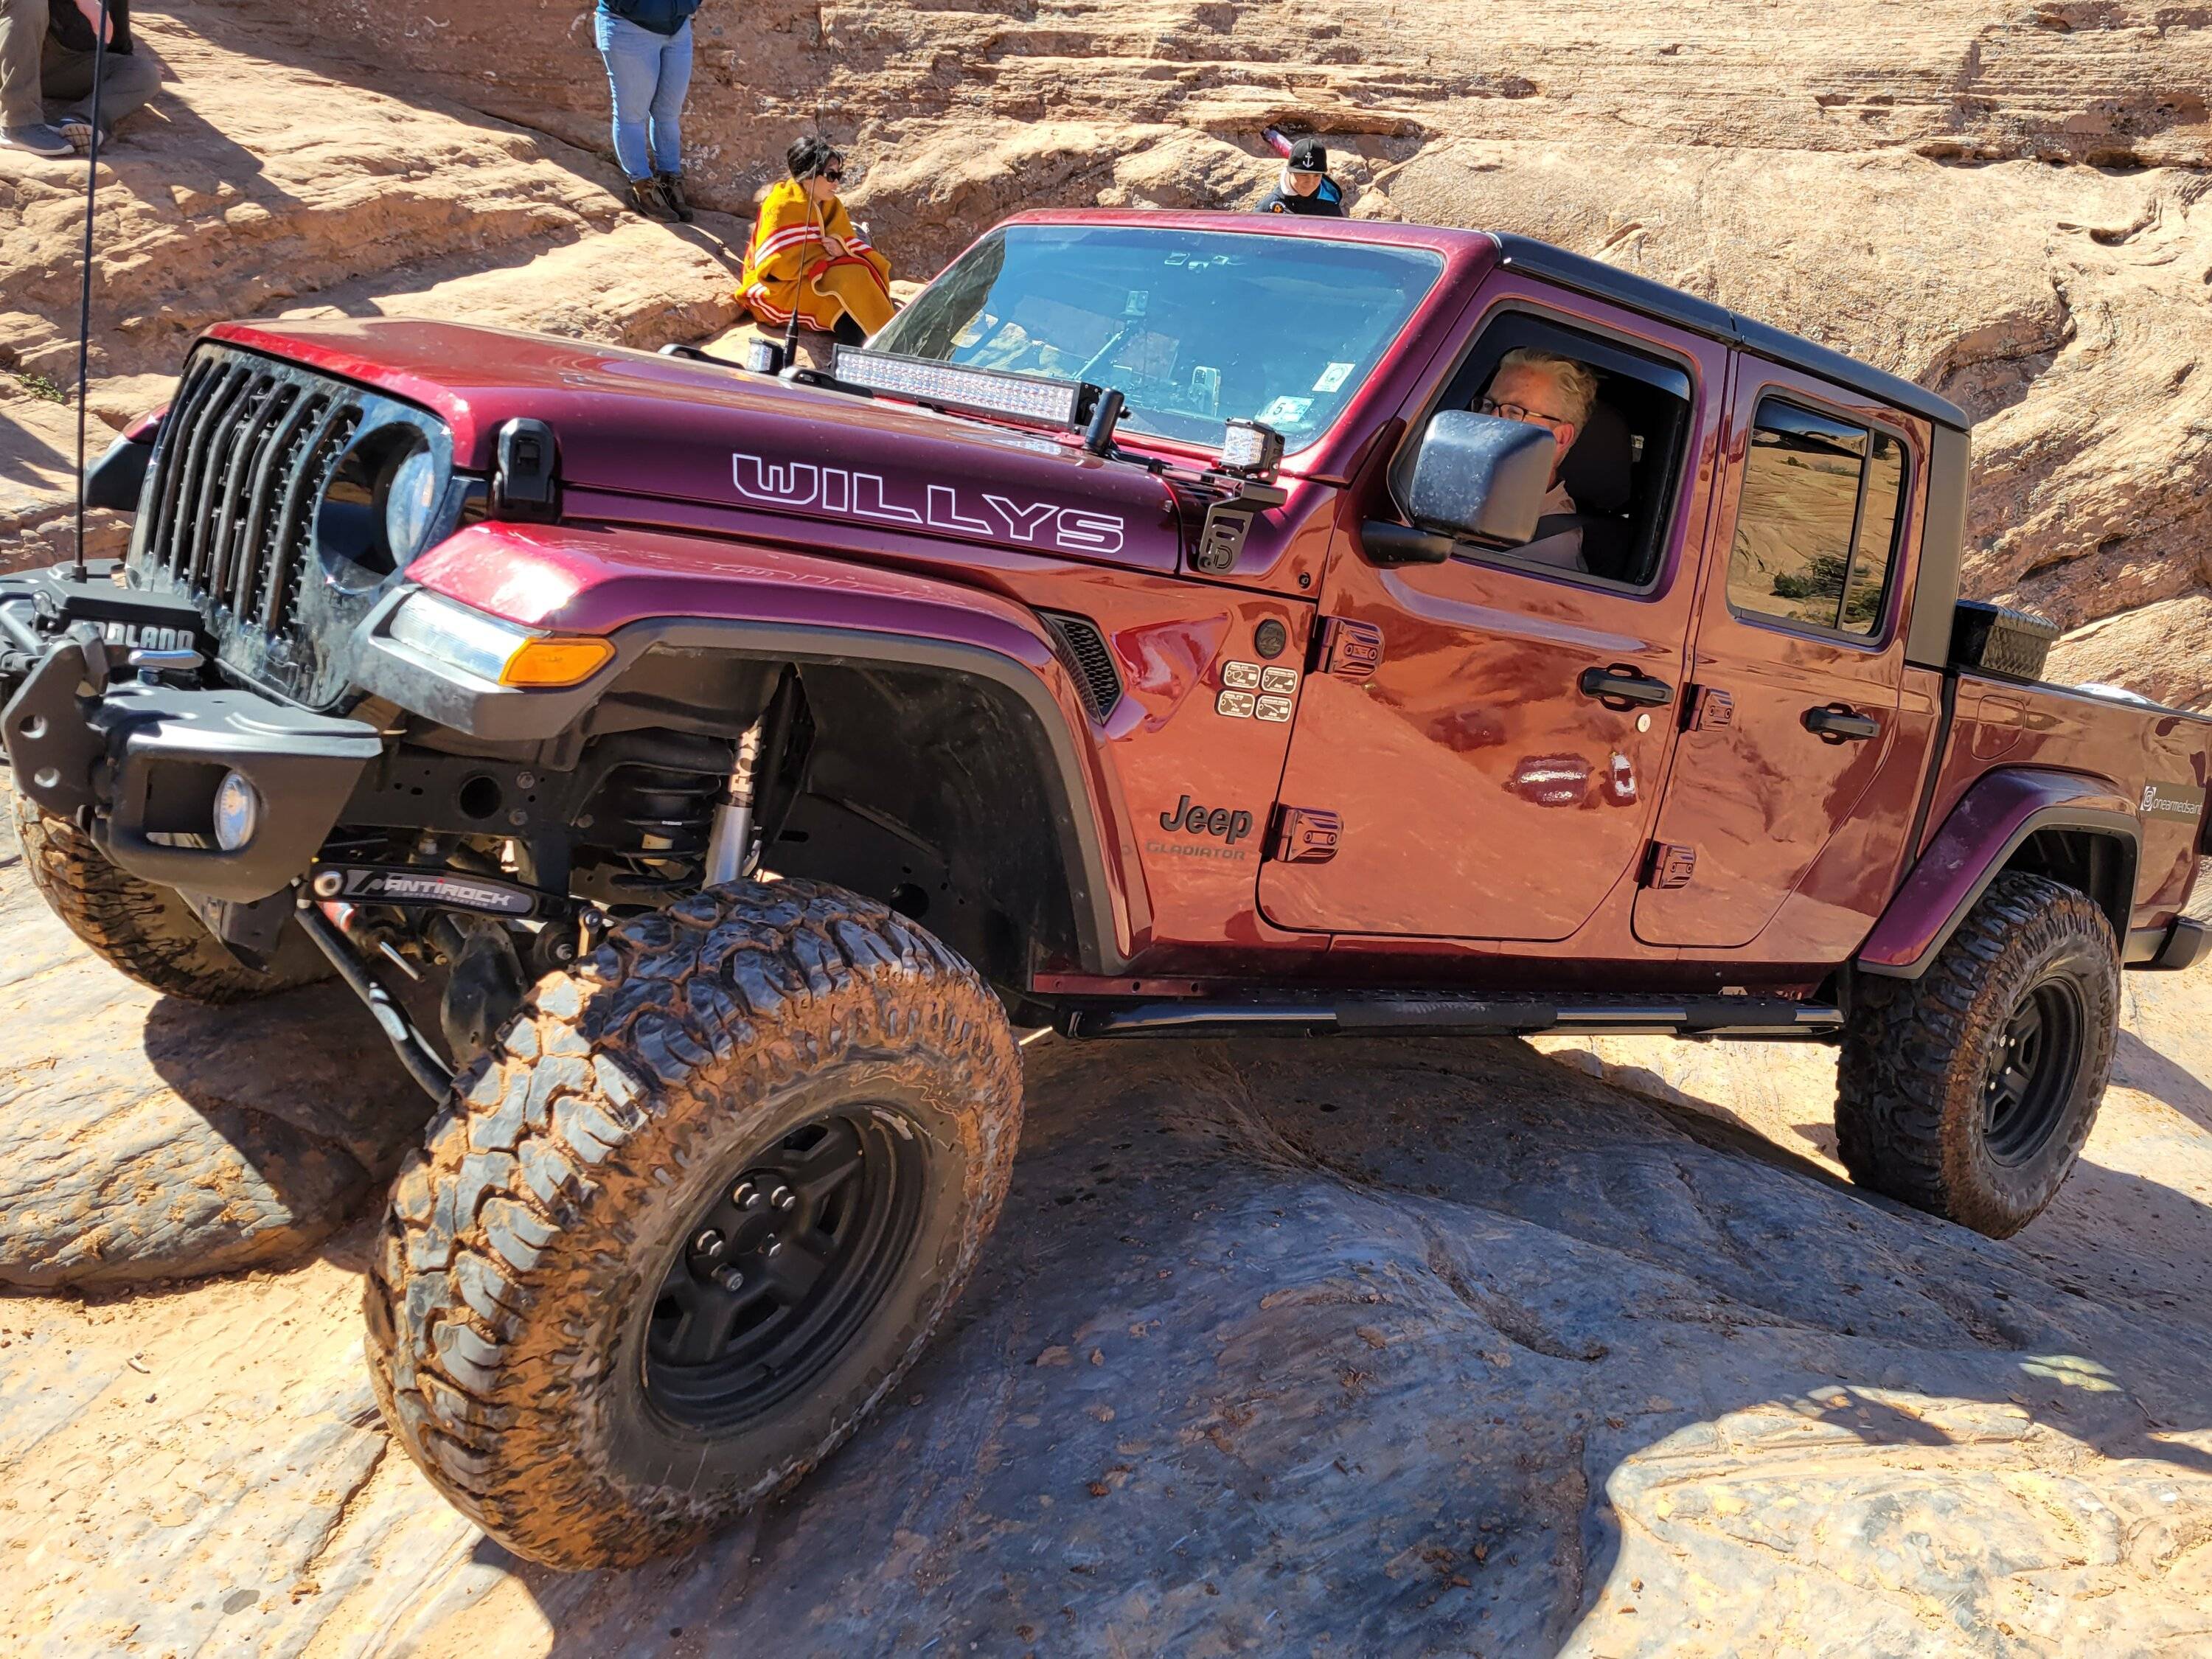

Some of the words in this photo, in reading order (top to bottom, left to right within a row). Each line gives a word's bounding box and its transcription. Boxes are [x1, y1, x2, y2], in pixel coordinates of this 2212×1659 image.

[732, 453, 1124, 554] WILLYS
[70, 619, 196, 650] DLAND
[728, 726, 762, 796] FOX
[1160, 794, 1253, 844] Jeep
[1145, 841, 1246, 860] GLADIATOR
